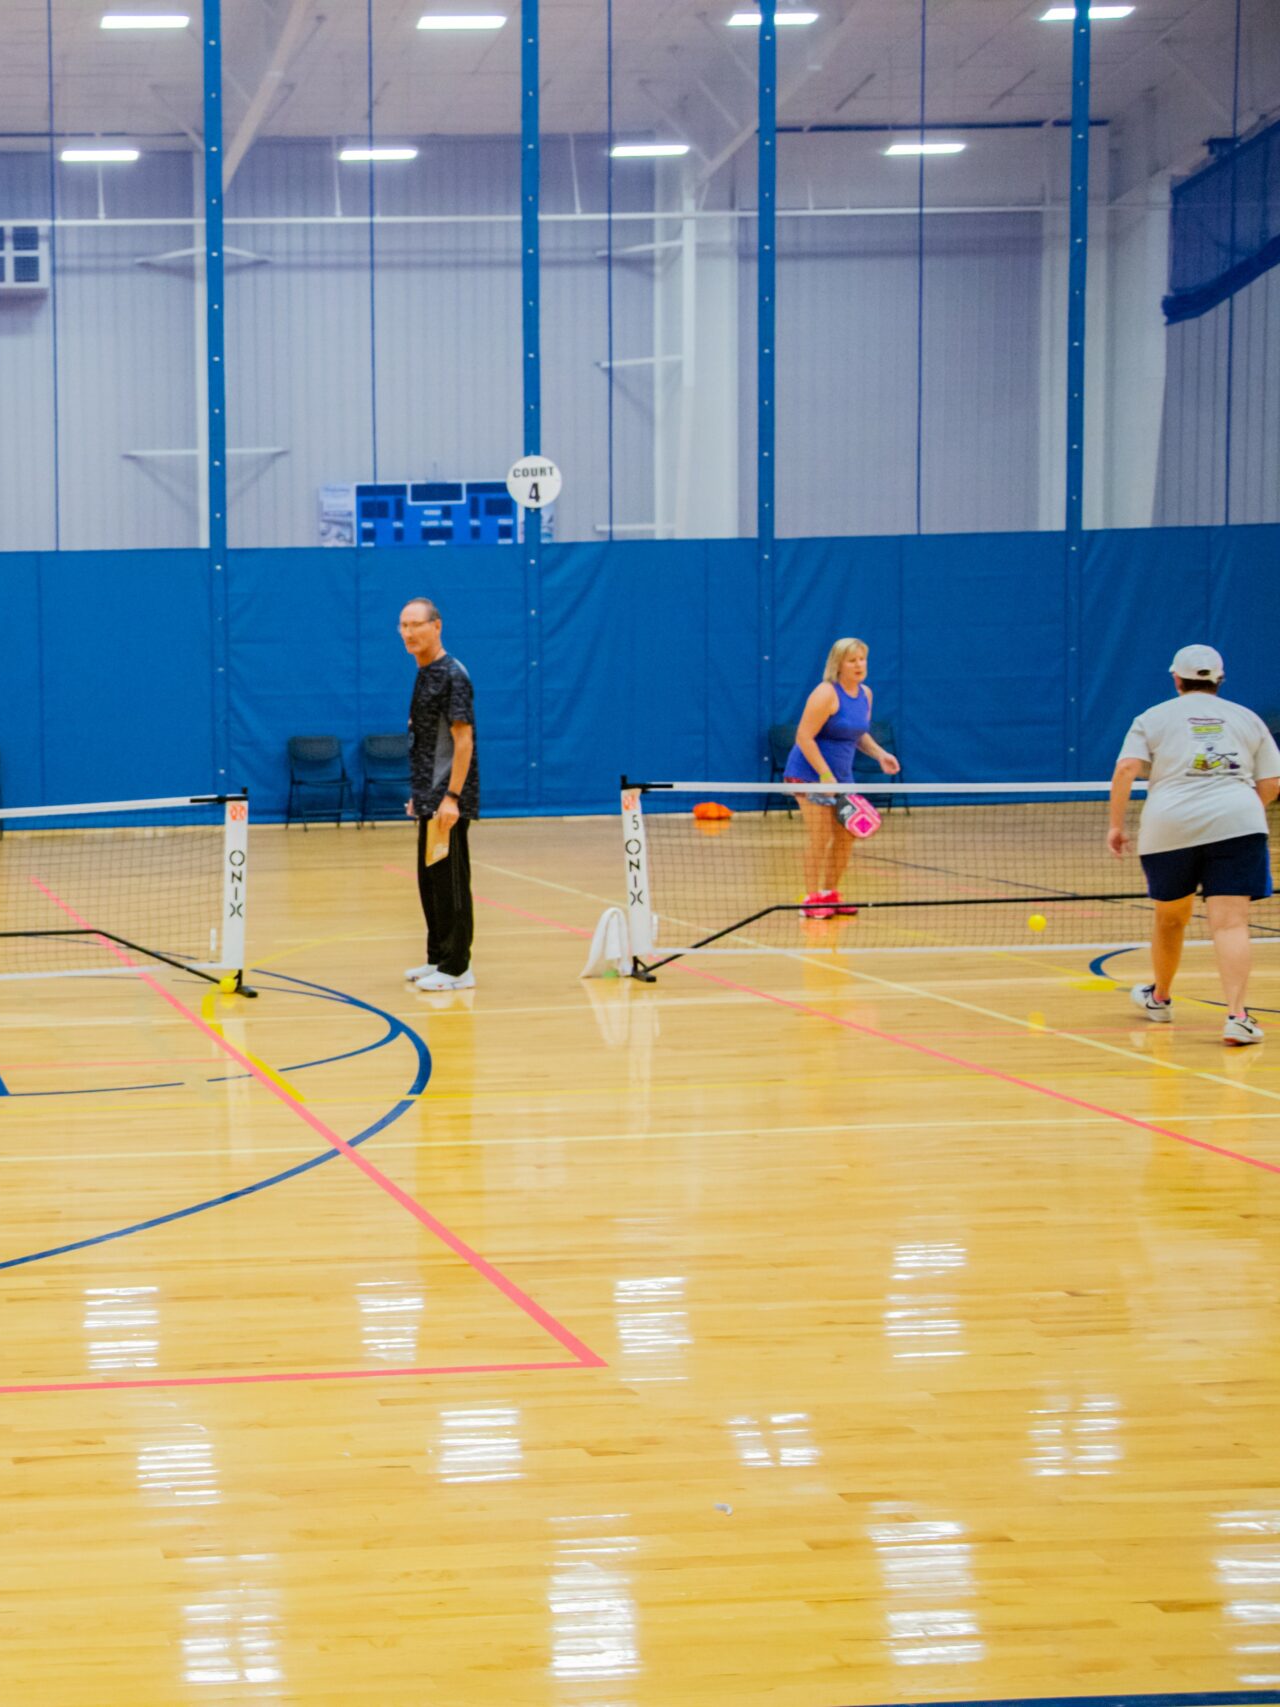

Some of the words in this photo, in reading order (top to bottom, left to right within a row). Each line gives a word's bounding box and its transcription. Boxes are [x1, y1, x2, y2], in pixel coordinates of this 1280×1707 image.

[513, 466, 553, 478] COURT
[529, 482, 540, 502] 4
[229, 850, 245, 918] ONIX
[625, 839, 643, 906] ONIX
